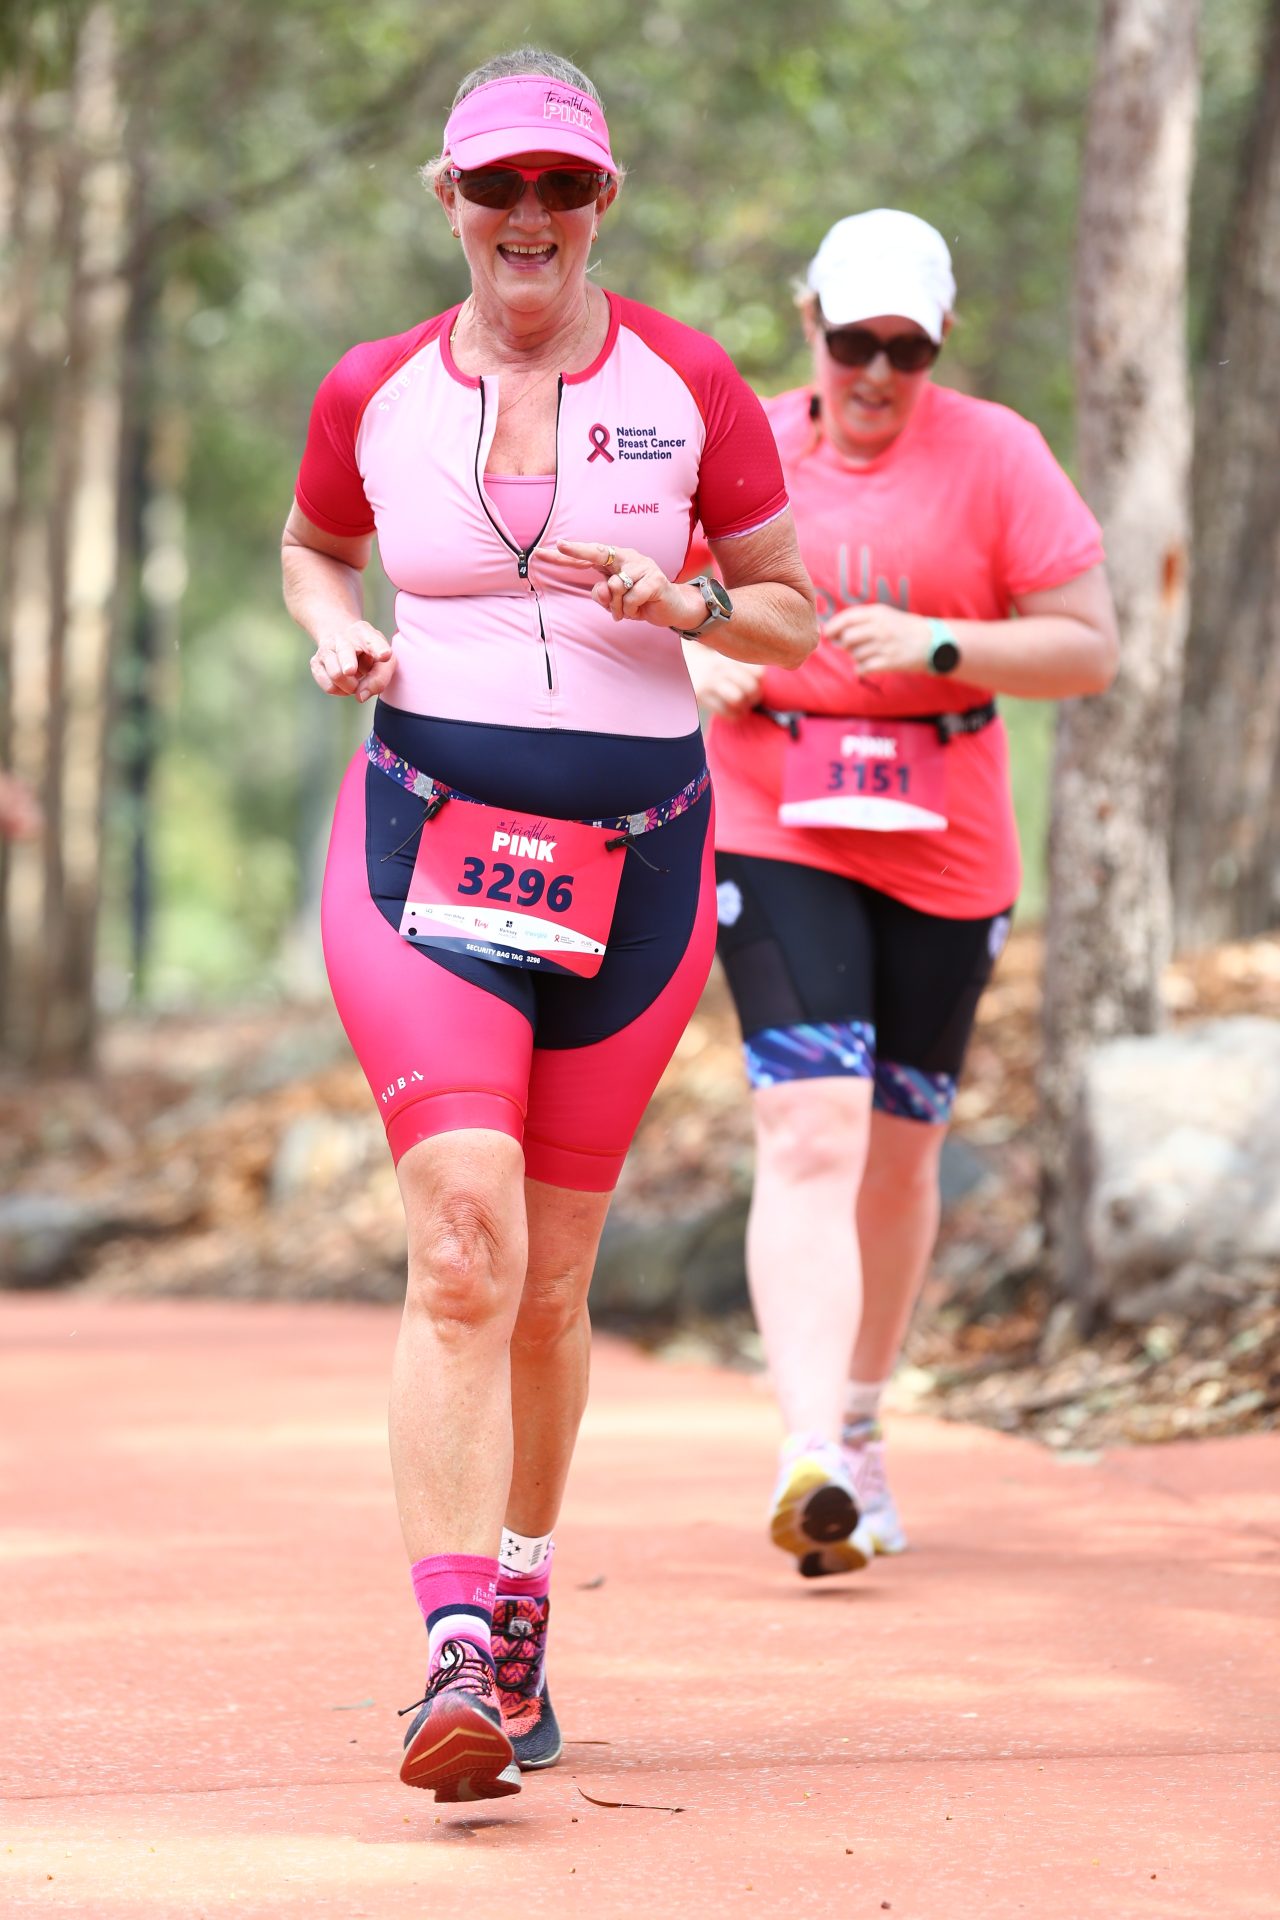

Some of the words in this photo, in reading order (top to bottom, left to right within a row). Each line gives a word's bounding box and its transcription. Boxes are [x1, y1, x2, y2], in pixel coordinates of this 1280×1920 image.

[543, 102, 594, 134] PINK
[616, 426, 657, 437] National
[618, 438, 648, 448] Breast
[651, 438, 686, 448] Cancer
[619, 449, 672, 460] Foundation
[614, 503, 659, 514] LEANNE
[828, 762, 909, 794] 3151
[491, 831, 557, 863] PINK
[457, 856, 574, 913] 3296
[466, 943, 496, 956] SECURITY
[496, 950, 510, 959] BAG
[511, 953, 523, 961] TAG
[526, 955, 541, 964] 3296
